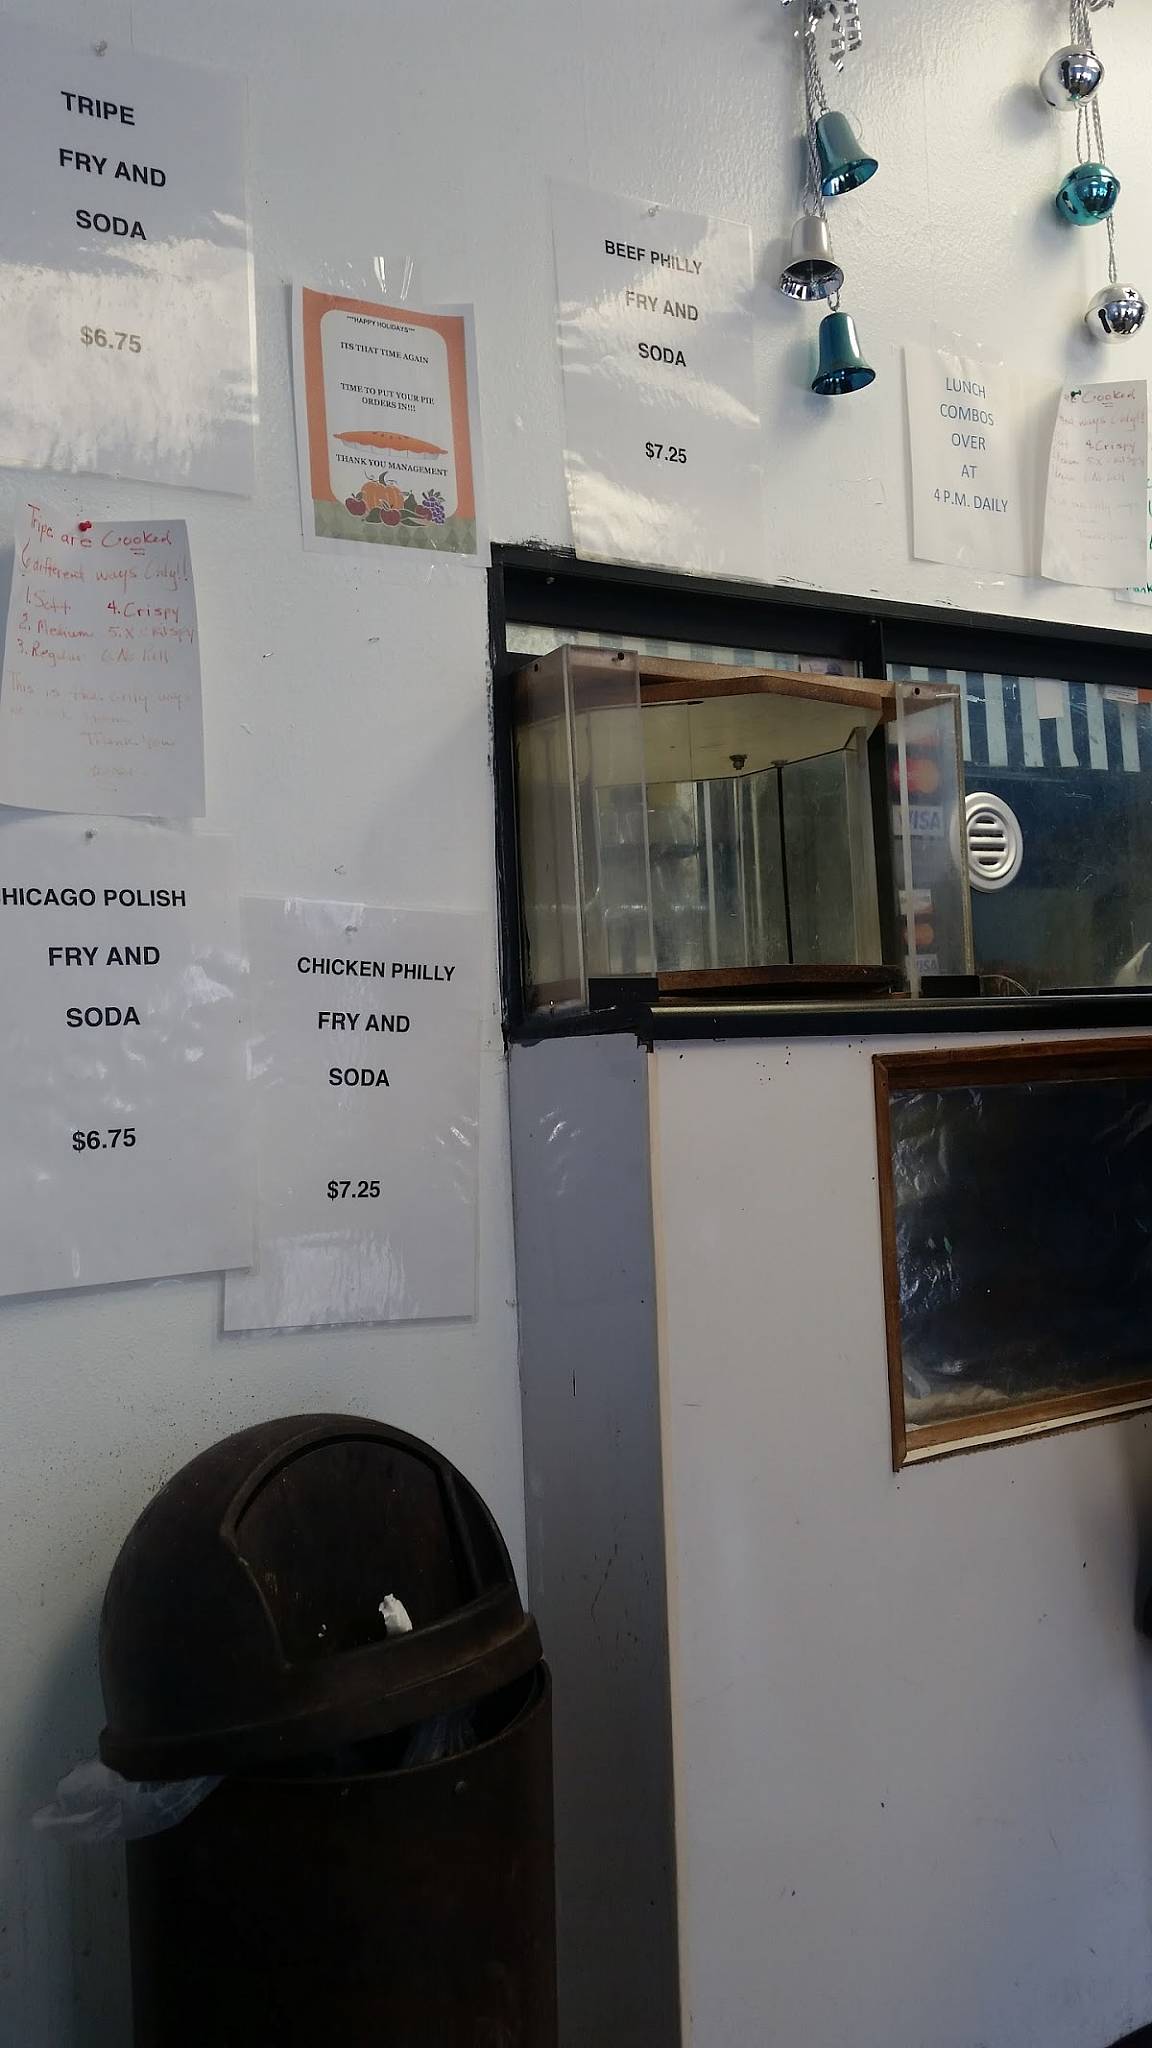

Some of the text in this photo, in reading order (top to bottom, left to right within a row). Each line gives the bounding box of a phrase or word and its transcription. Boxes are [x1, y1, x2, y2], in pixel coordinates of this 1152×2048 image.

[61, 91, 135, 126] TRIPE
[59, 148, 166, 187] FRY AND
[76, 209, 147, 240] SODA
[604, 240, 702, 275] BEEF PHILLY
[625, 290, 699, 321] FRY AND
[80, 325, 142, 353] $6.75
[340, 341, 429, 364] ITS THAT TIME AGAIN
[638, 342, 687, 367] SODA
[340, 382, 363, 393] TIME
[364, 386, 376, 395] TO
[378, 388, 394, 398] PUT
[396, 391, 419, 402] YOUR
[945, 377, 986, 399] LUNCH
[361, 396, 397, 409] ORDERS
[940, 403, 994, 426] COMBOS
[645, 441, 687, 464] $7.25
[951, 432, 986, 451] OVER
[335, 453, 448, 477] THANK YOU MANAGEMENT
[961, 464, 977, 479] AT
[934, 488, 1008, 512] 4 P.M. DAILY
[61, 533, 92, 548] are
[101, 529, 173, 549] Cooked
[1, 887, 187, 908] HICAGO POLISH
[48, 946, 160, 966] FRY AND
[297, 957, 455, 982] CHICKEN PHILLY
[66, 1006, 141, 1028] SODA
[318, 1011, 410, 1033] FRY AND
[328, 1067, 390, 1087] SODA
[72, 1127, 136, 1153] $6.75
[327, 1179, 381, 1201] $7.25
